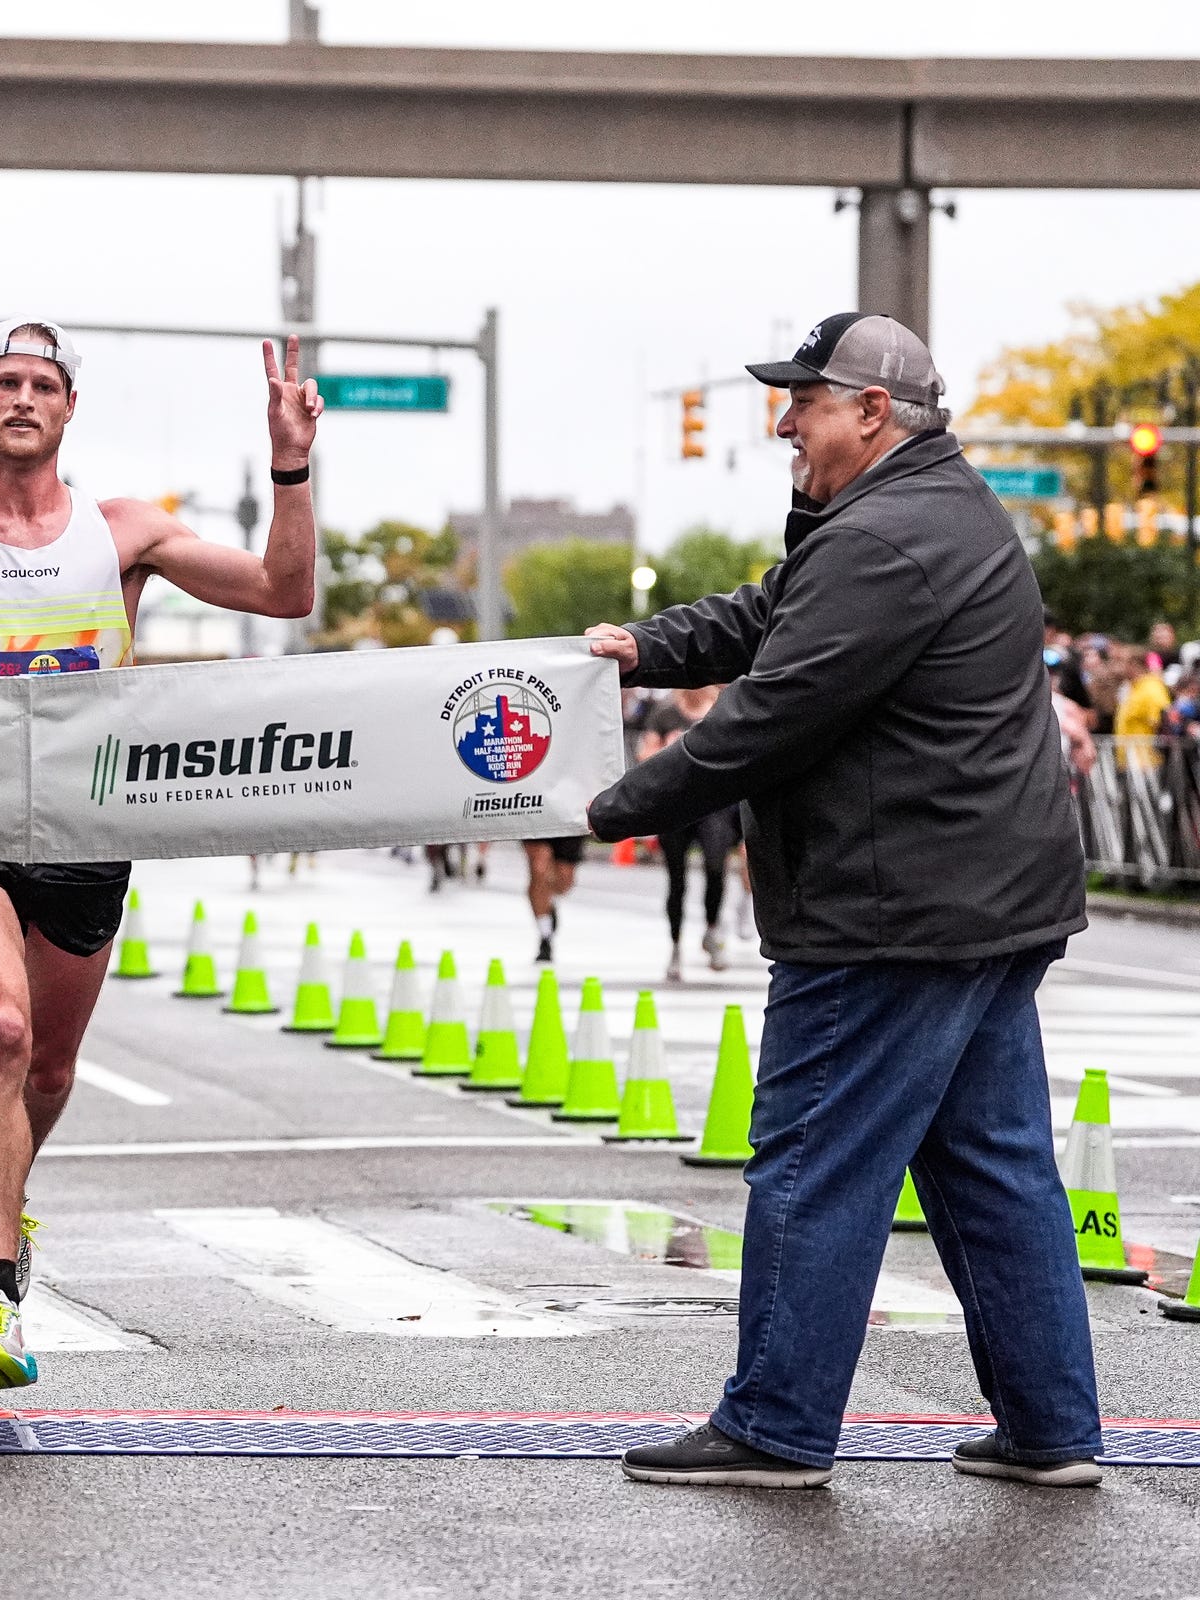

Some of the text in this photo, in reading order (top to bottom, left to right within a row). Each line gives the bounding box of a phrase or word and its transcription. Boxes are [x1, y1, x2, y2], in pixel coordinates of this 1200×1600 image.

[1, 566, 60, 579] saucony
[440, 668, 562, 721] DETROIT FREE PRESS
[484, 736, 522, 746] MARATHON
[126, 721, 353, 782] msufcu
[474, 744, 534, 756] HALF-MARATHON
[486, 753, 523, 763] RELAY 5K
[488, 761, 522, 771] KIDS RUN
[126, 779, 353, 805] MSU FEDERAL CREDIT UNION
[473, 793, 542, 812] msufcu
[1074, 1210, 1117, 1238] AS
